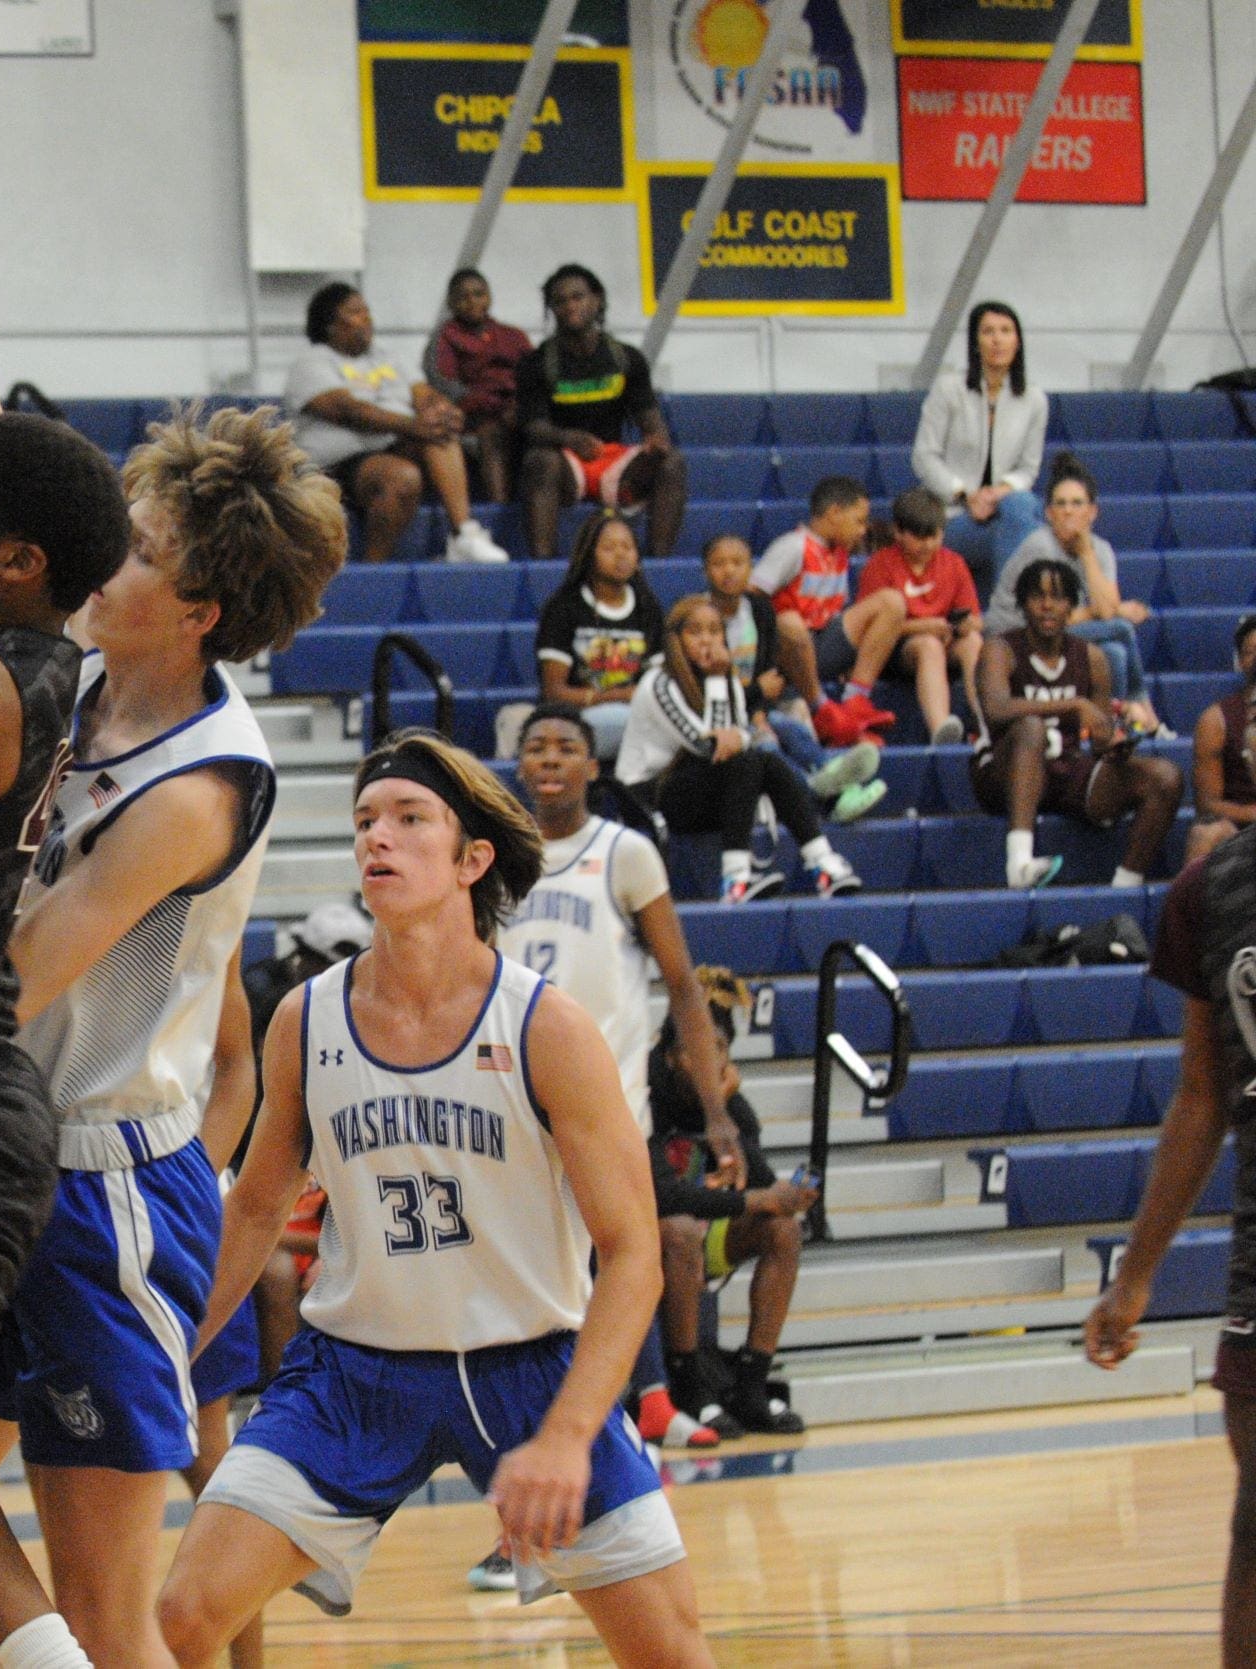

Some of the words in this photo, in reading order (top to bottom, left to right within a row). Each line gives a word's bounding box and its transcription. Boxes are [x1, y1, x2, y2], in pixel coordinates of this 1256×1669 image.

[434, 92, 562, 125] CHIPA
[1052, 94, 1133, 122] OLLEGE
[953, 132, 1093, 171] RAIERS
[764, 209, 859, 240] COAST
[329, 1094, 506, 1164] WASHINGTON
[377, 1171, 474, 1257] 33
